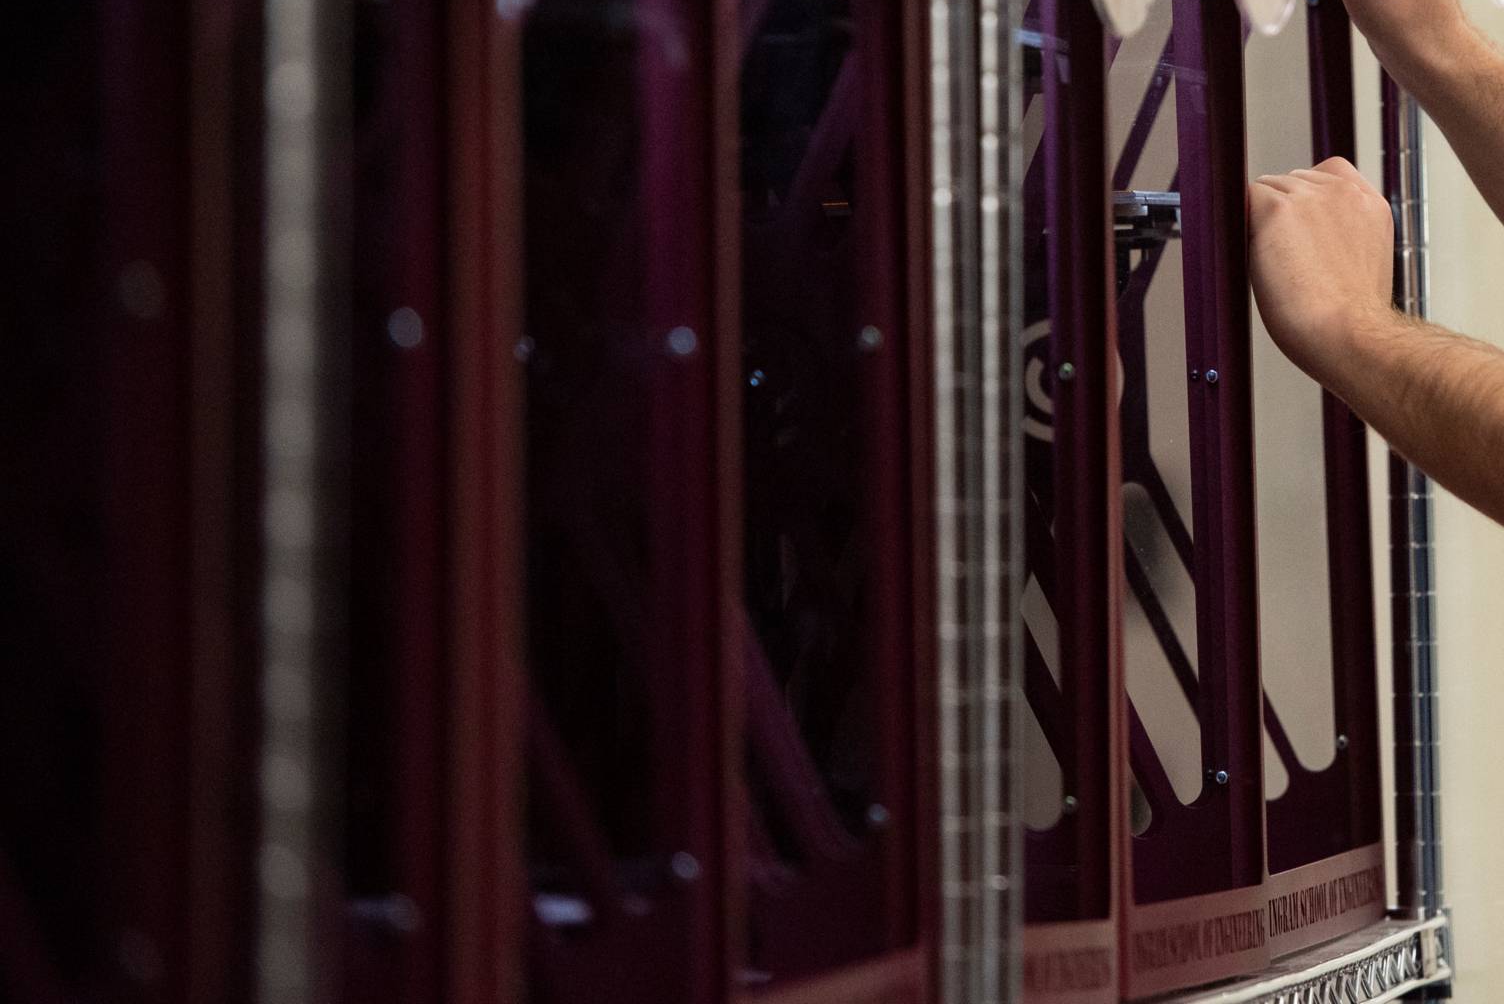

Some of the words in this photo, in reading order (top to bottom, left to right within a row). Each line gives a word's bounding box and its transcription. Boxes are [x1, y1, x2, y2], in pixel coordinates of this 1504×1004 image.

[1269, 892, 1299, 937] INGRAM
[1300, 883, 1328, 928] SCHOOL
[1329, 879, 1338, 918] OF
[1339, 864, 1383, 914] ENGINEE
[1215, 908, 1265, 956] ENGINEERING
